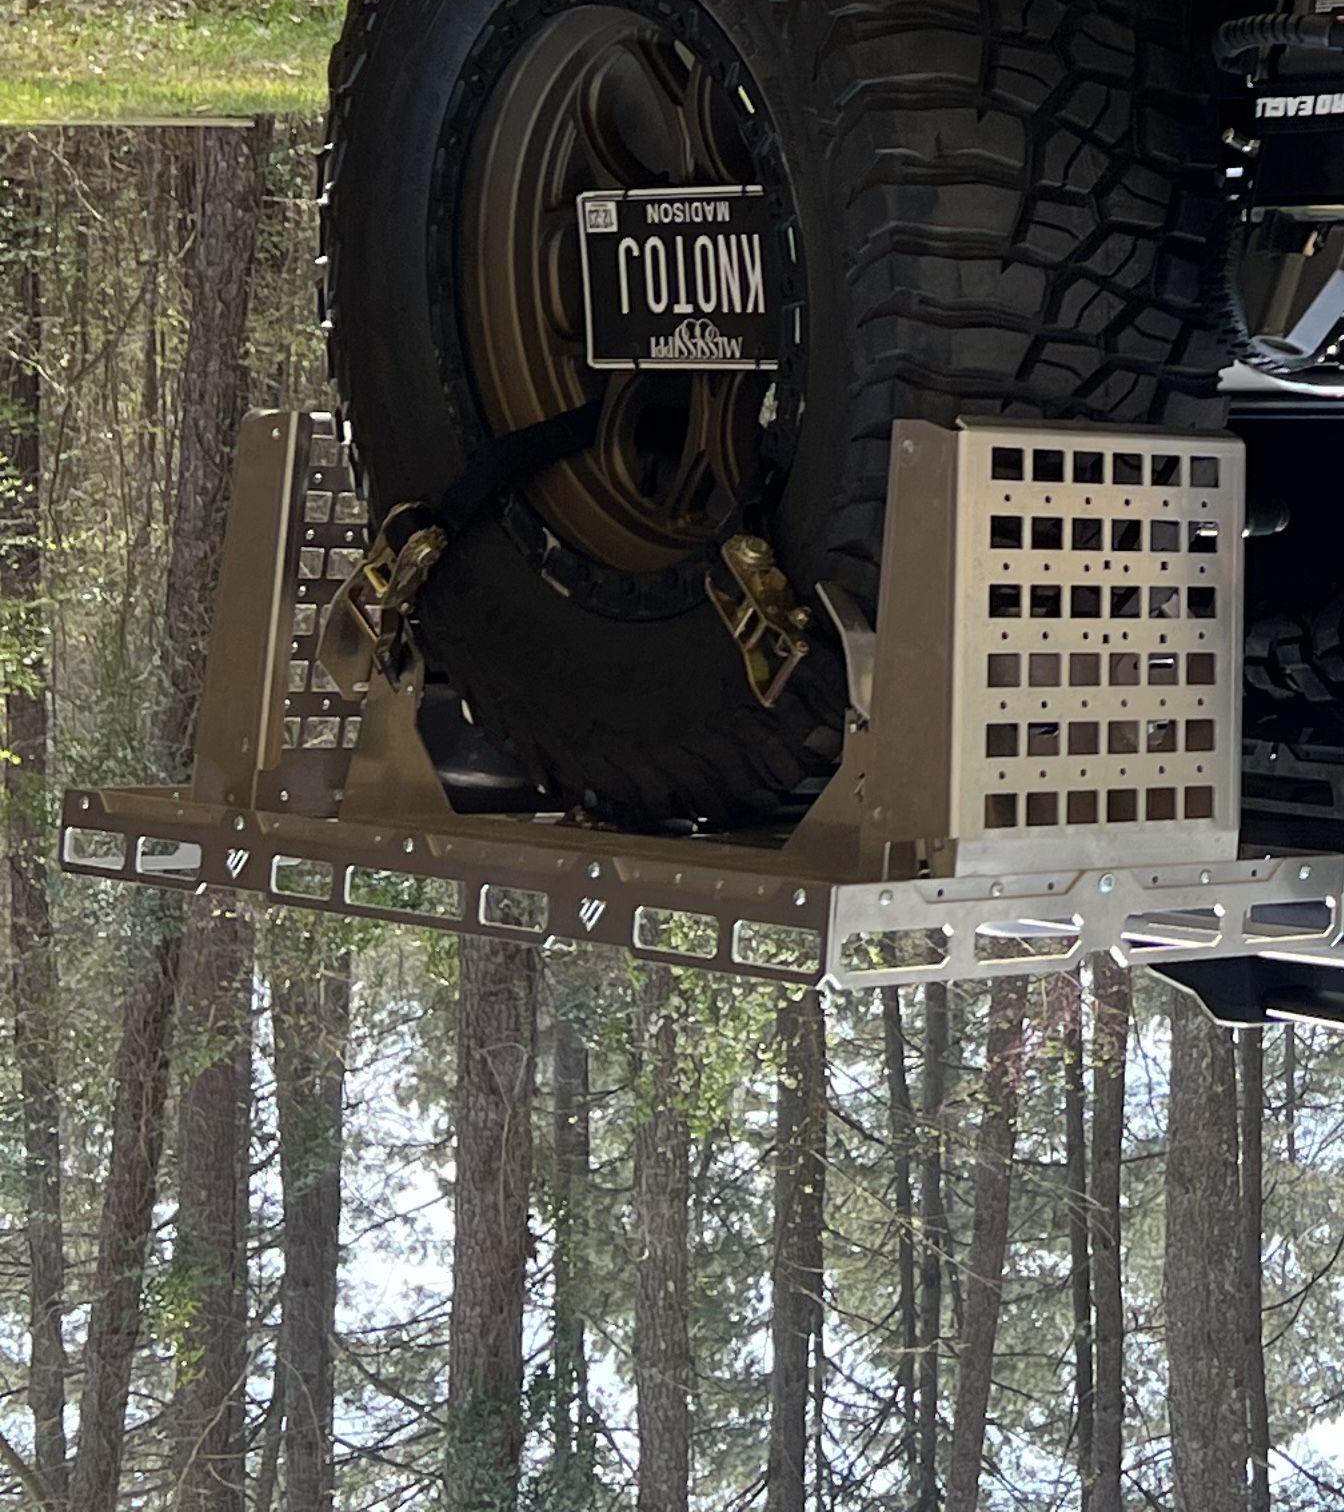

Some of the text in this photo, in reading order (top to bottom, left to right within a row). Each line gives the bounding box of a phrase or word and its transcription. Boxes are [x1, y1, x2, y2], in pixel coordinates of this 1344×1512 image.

[645, 201, 730, 223] MADISON
[618, 233, 765, 314] KNOTOJ
[649, 318, 743, 359] MISSISSIPPI
